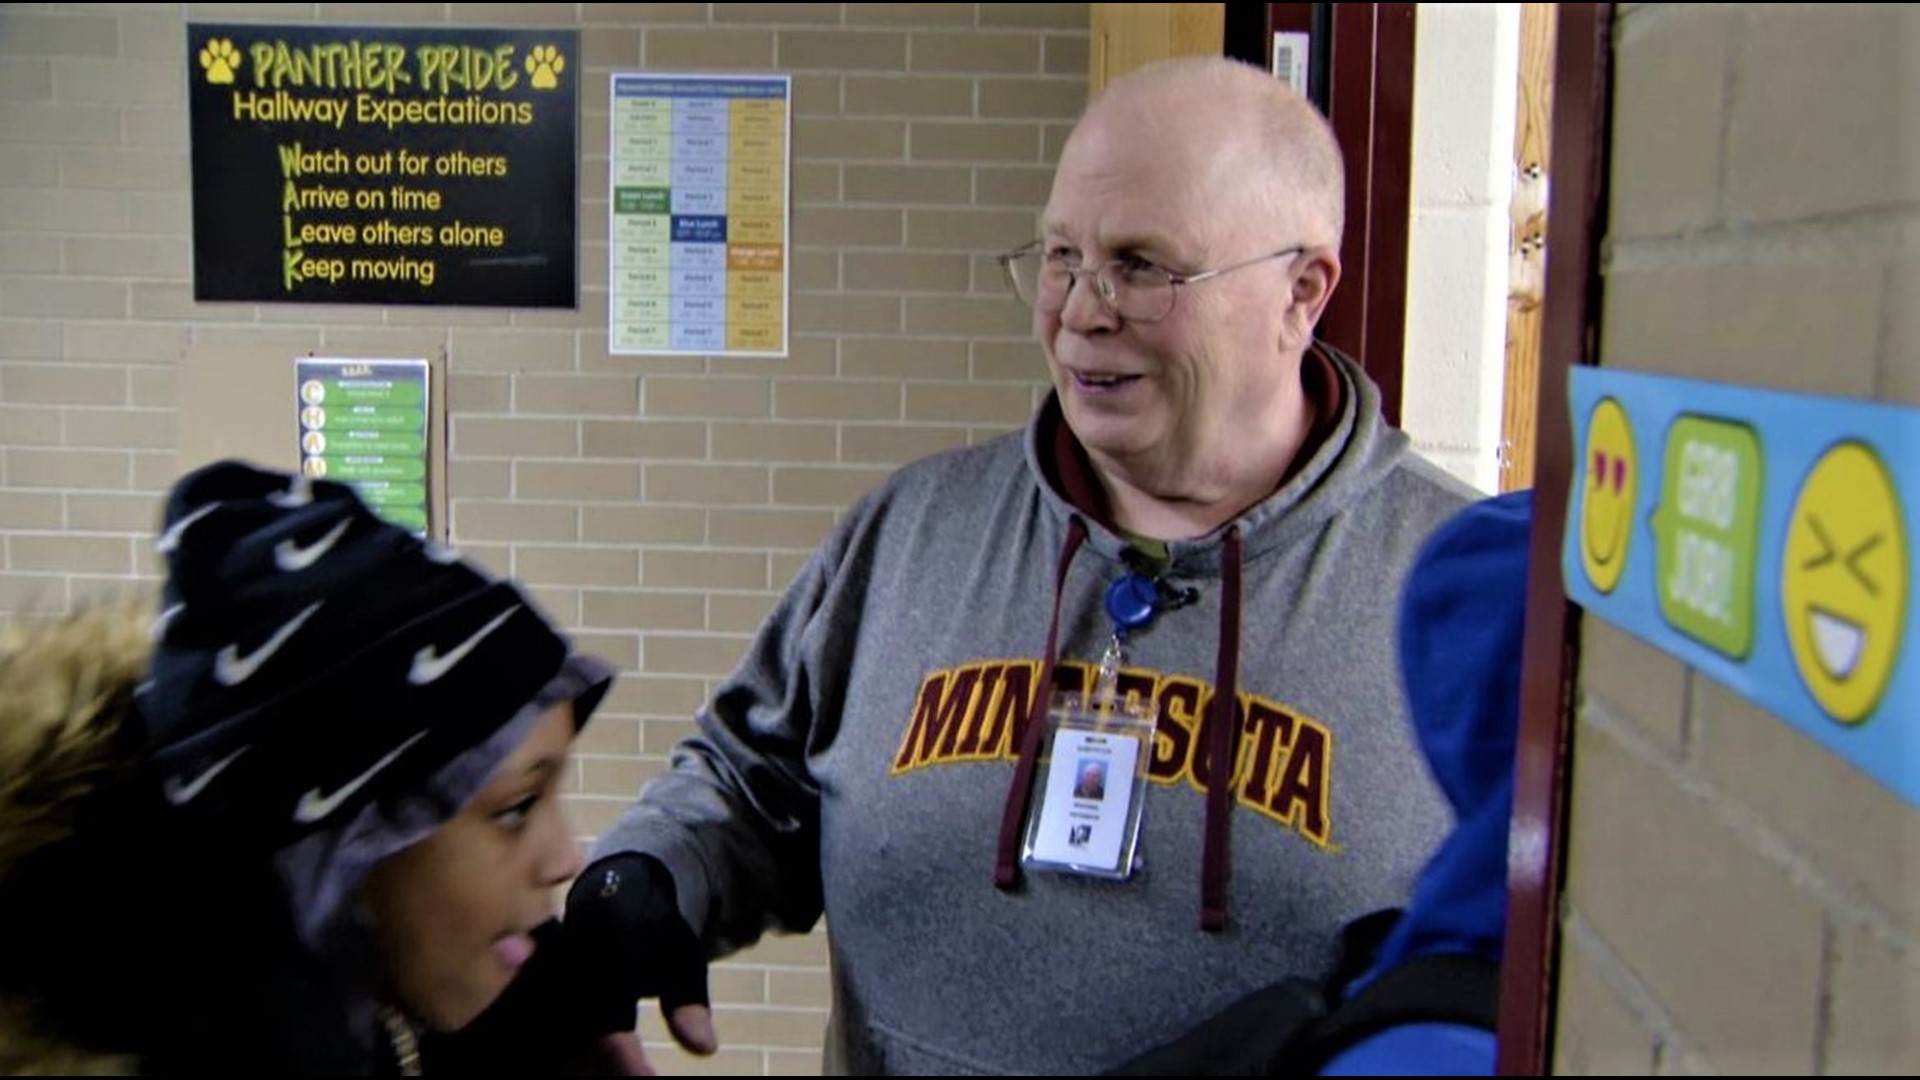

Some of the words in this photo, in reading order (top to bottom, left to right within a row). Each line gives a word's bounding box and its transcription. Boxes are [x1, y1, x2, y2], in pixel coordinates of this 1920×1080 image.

[250, 40, 411, 93] PANTHER
[416, 44, 519, 93] PRIDE
[233, 91, 349, 128] Hallway
[356, 93, 534, 129] Expectations
[278, 143, 350, 178] Watch
[355, 152, 393, 175] out
[397, 149, 430, 176] for
[435, 150, 508, 177] others
[282, 180, 350, 212] Arrive
[355, 190, 385, 210] on
[390, 186, 442, 211] time
[283, 215, 357, 248] Leave
[361, 220, 434, 246] others
[439, 221, 505, 247] alone
[284, 250, 346, 291] Keep
[351, 256, 435, 285] moving
